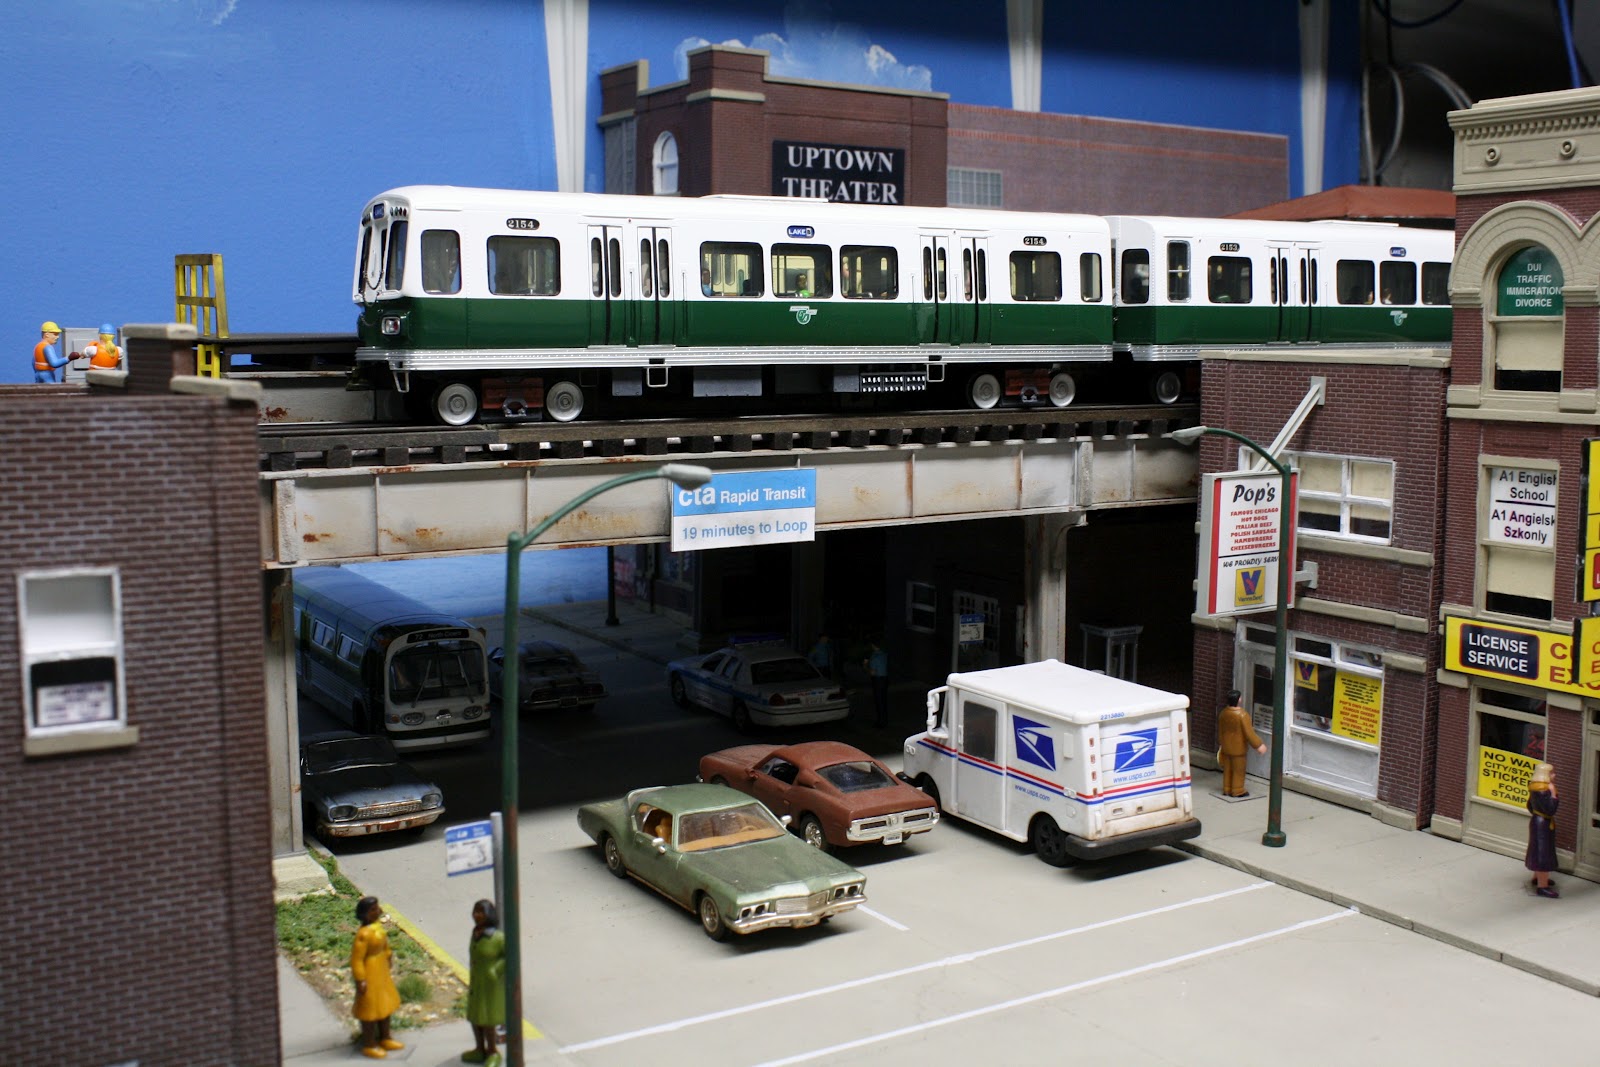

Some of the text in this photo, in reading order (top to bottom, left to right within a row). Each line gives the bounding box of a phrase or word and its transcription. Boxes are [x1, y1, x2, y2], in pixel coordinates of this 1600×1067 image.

[787, 145, 894, 173] UPTOWN
[782, 177, 898, 204] THEATER
[507, 219, 535, 229] 2154
[788, 228, 806, 236] LAKE
[1025, 237, 1045, 246] 2154
[1527, 263, 1542, 272] DUI
[1516, 275, 1552, 284] TRAFFIC
[1506, 286, 1562, 296] IMMIGRATION
[1515, 298, 1552, 308] DIVORCE
[1499, 470, 1514, 482] A1
[720, 489, 759, 505] Rapid
[763, 486, 806, 501] Transit
[1232, 482, 1276, 505] Pop's
[1510, 487, 1549, 501] School
[1230, 509, 1253, 517] FAMOUS
[1491, 509, 1506, 521] A1
[682, 520, 808, 540] 19 minutes to Loop
[1504, 526, 1547, 544] Szkonly
[1230, 542, 1276, 551] CHEESEBURGERS
[1234, 535, 1273, 544] HAMBURGERS
[1468, 632, 1529, 655] LICENSE
[1467, 650, 1528, 673] SERVICE
[1484, 751, 1536, 771] NO WAI
[1113, 770, 1156, 783] www.usps.com
[1484, 761, 1534, 778] CITY/STAT
[1482, 768, 1532, 787] STICKE
[1014, 784, 1051, 801] www.usps.com
[1498, 782, 1529, 796] FOOD
[1491, 789, 1528, 804] STAMP
